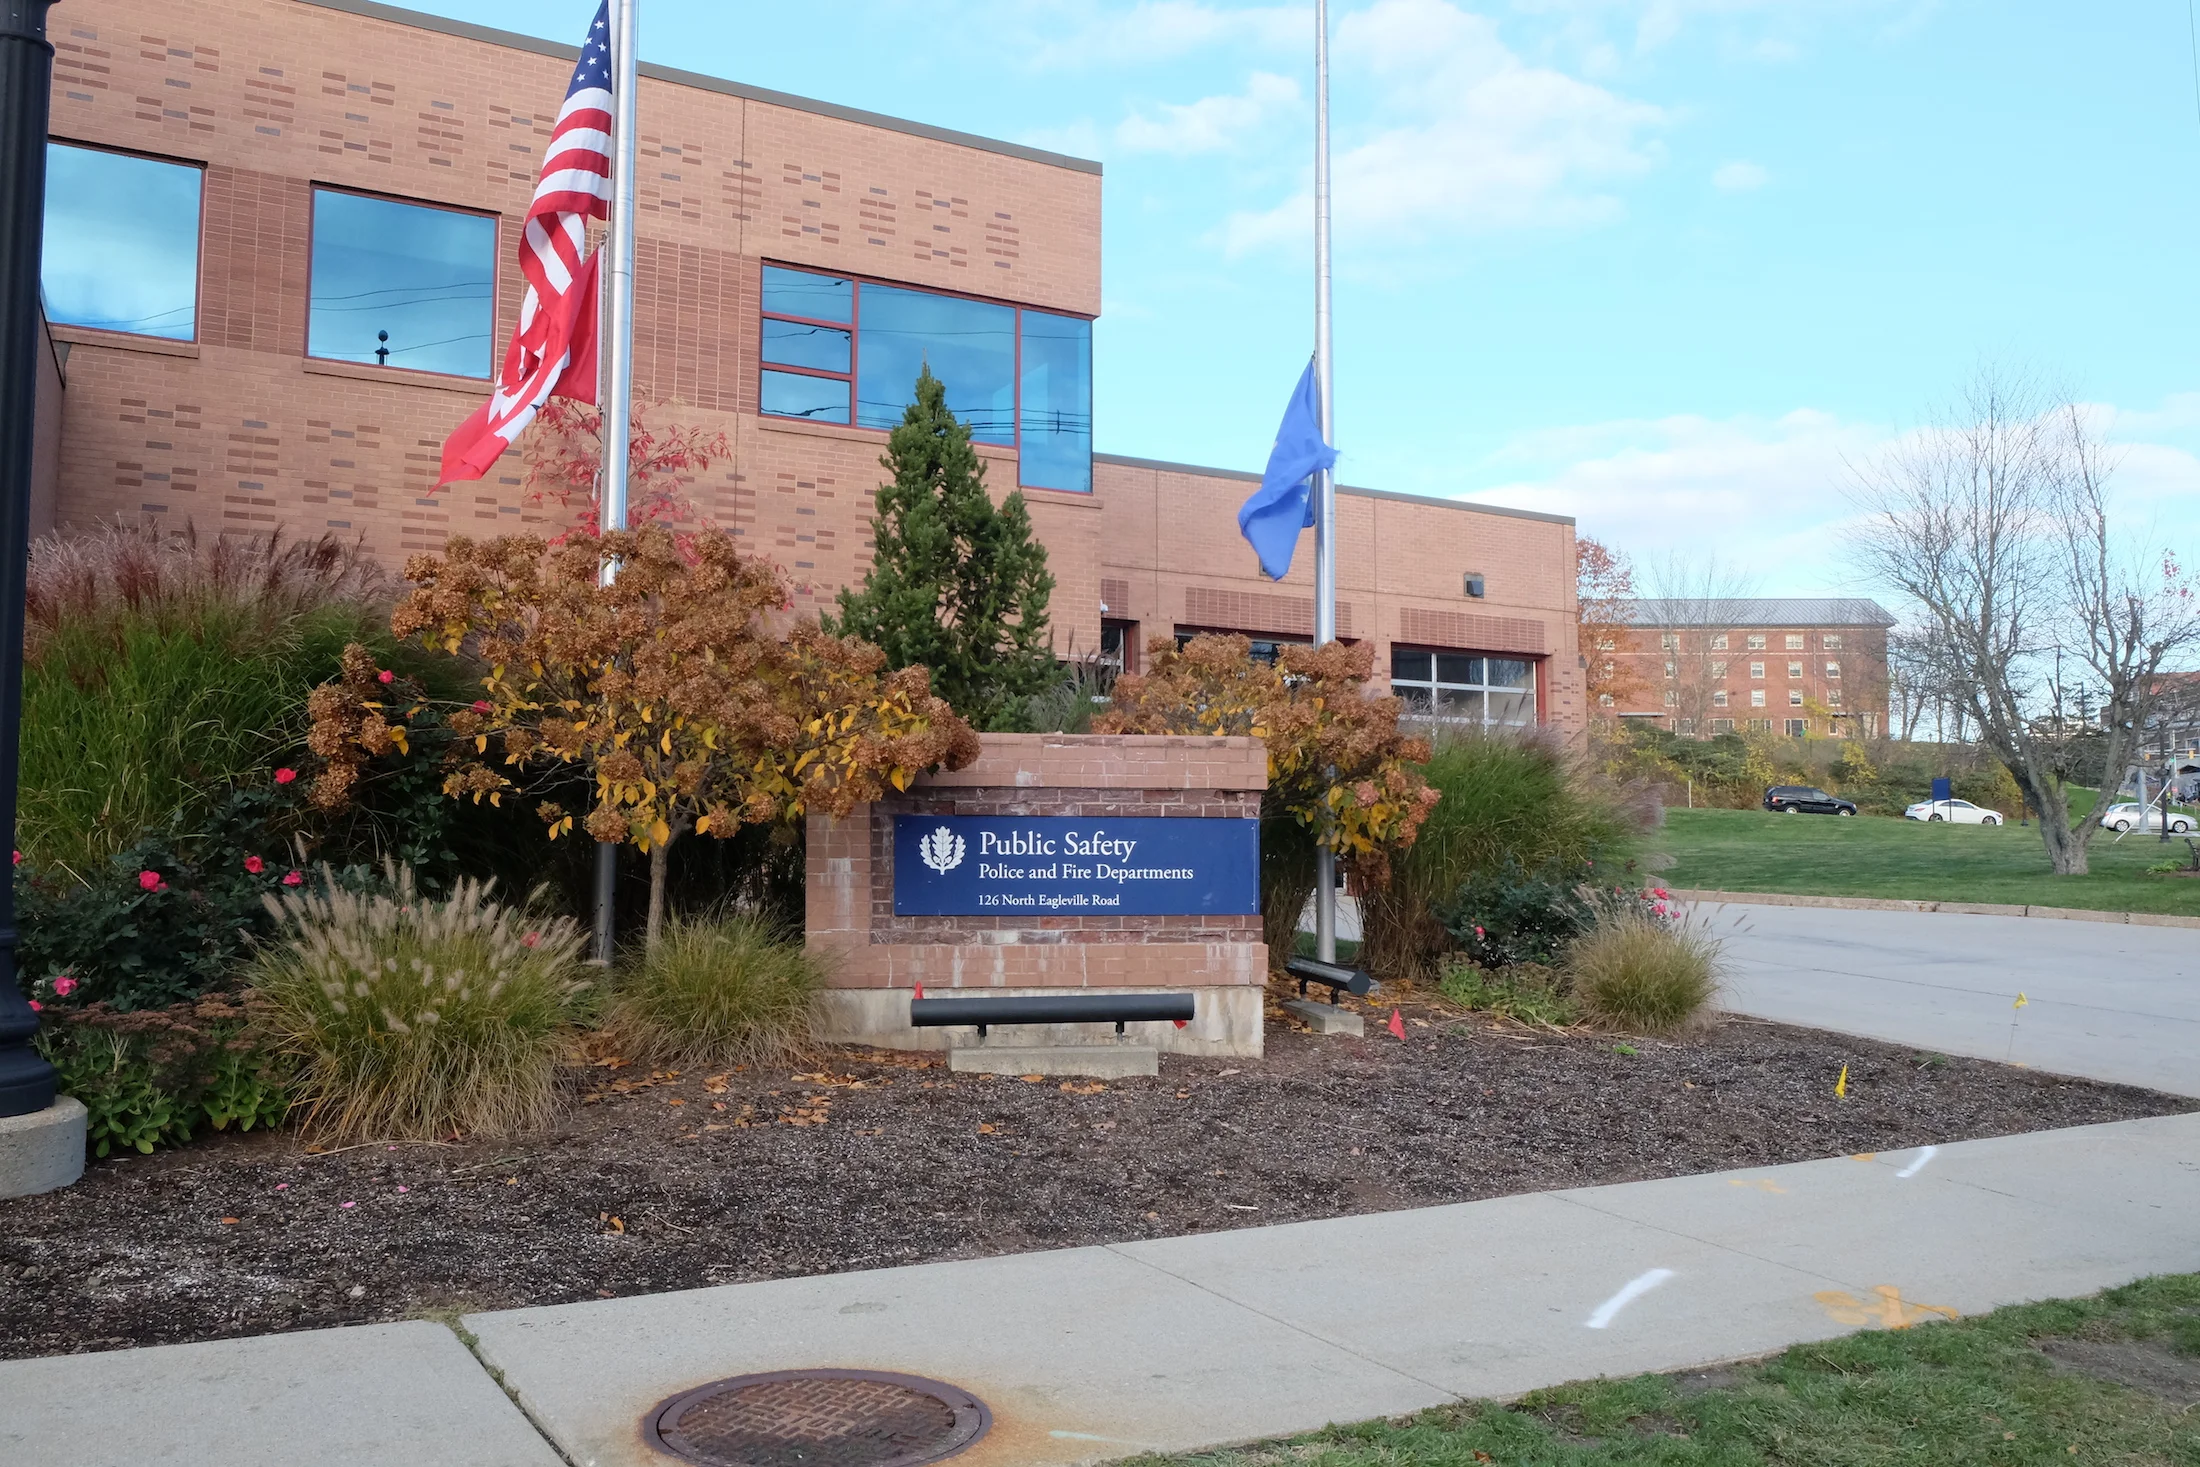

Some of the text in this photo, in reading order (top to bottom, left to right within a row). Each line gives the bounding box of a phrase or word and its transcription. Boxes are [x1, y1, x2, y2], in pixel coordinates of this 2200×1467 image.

[979, 830, 1137, 863] Public Safety
[979, 862, 1194, 884] Police and Fire Departments
[979, 893, 1120, 910] 126 North Eagleville Road
